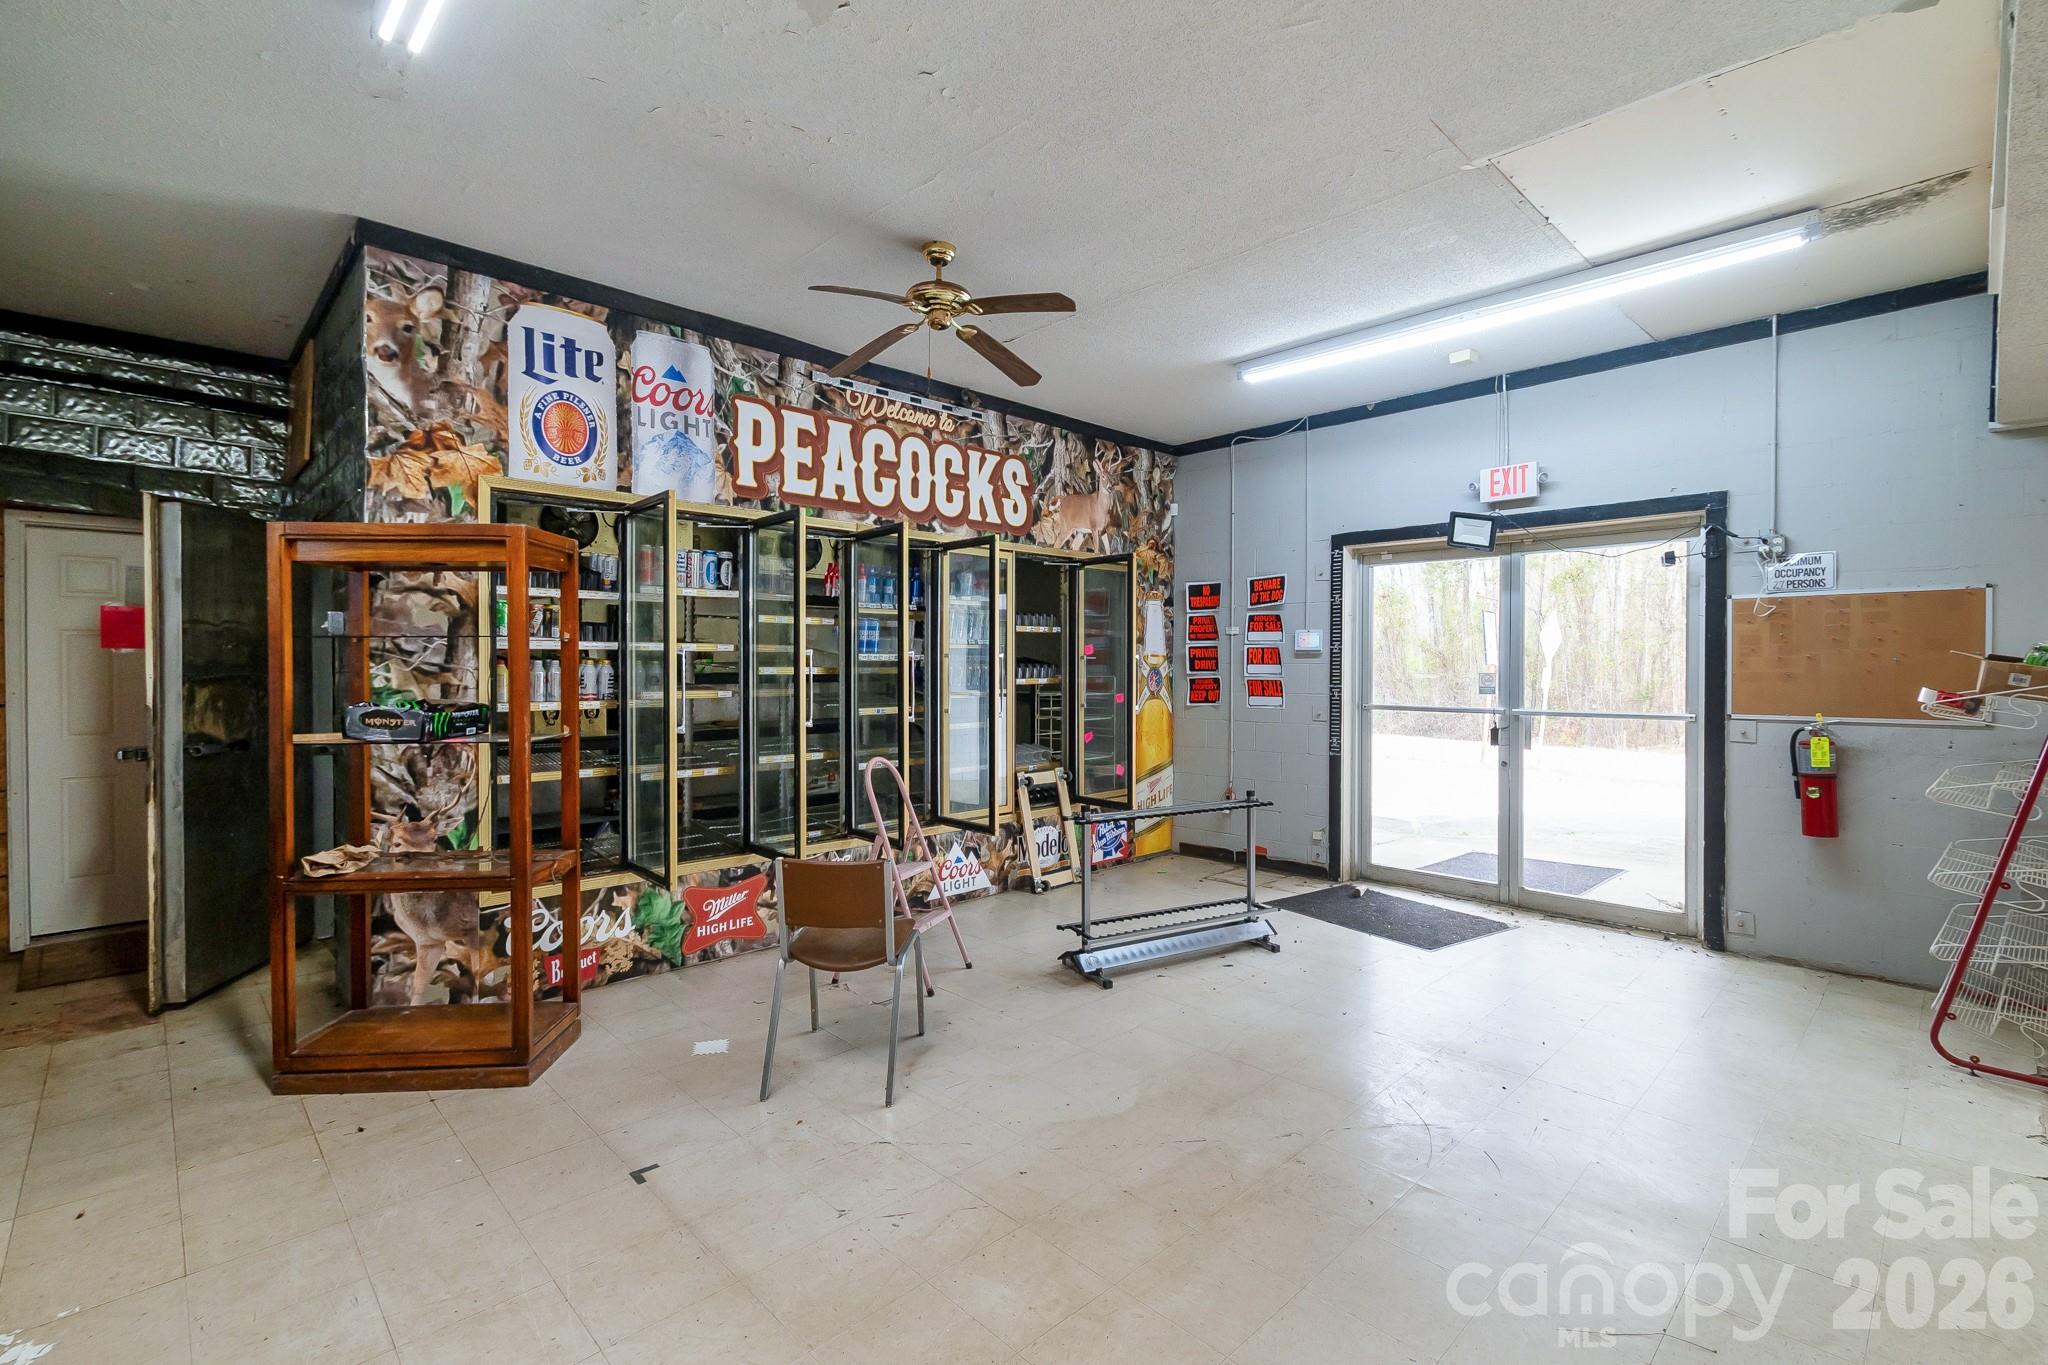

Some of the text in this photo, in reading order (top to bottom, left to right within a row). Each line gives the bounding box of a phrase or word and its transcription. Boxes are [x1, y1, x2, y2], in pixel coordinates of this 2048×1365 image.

[520, 326, 604, 385] Lite
[631, 365, 714, 418] Coors
[534, 392, 596, 429] A FINE PILSNER
[845, 388, 955, 433] Welcome to
[637, 405, 711, 438] LIGHT
[552, 453, 582, 465] BEER
[734, 398, 1030, 528] PEACOCKS
[1490, 464, 1529, 497] EXIT
[1774, 567, 1827, 578] OCCUPANCY
[1254, 578, 1281, 591] BEWARE
[1786, 579, 1826, 589] PERSONS
[1251, 593, 1259, 603] OF
[1260, 591, 1270, 602] THE
[1250, 620, 1281, 631] FOR SALE
[1190, 648, 1217, 658] PRIVATE
[1248, 648, 1280, 665] FOR RENT
[1194, 660, 1216, 670] DRIVE
[1248, 680, 1283, 697] FOR SALE
[365, 717, 417, 727] MONSTER
[1138, 792, 1157, 810] HIGH
[1158, 784, 1173, 802] LIFE
[938, 860, 982, 881] Coors
[943, 877, 976, 892] LIGHT
[703, 889, 750, 922] Miller
[697, 916, 754, 938] HIGH LIFE
[551, 951, 597, 984] Buet
